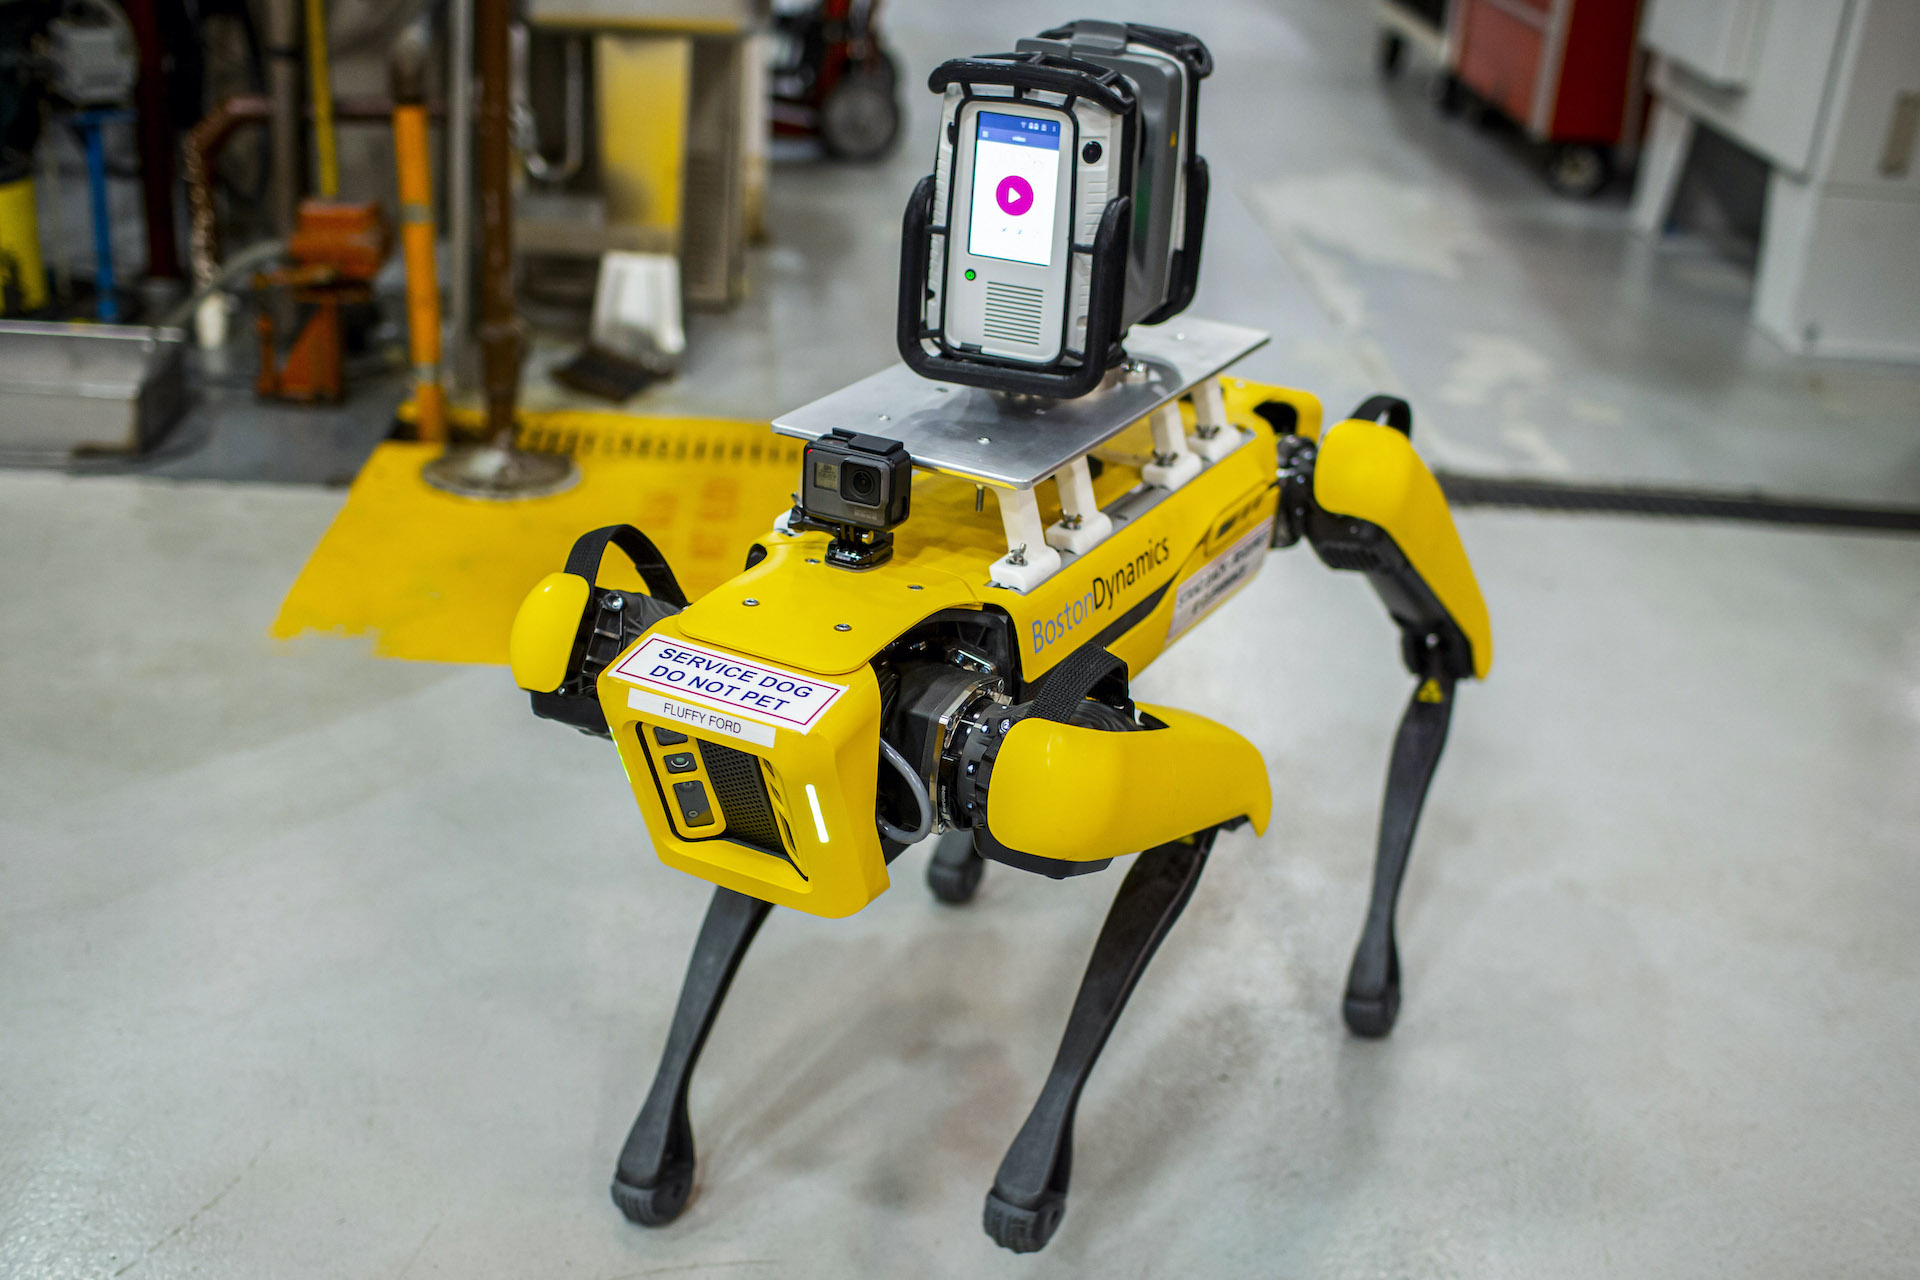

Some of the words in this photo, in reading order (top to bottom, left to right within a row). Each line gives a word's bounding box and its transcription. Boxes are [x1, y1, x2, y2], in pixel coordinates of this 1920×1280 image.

[649, 665, 686, 682] DO
[687, 676, 740, 696] NOT
[739, 690, 790, 711] PET
[658, 648, 758, 682] SERVICE
[758, 676, 813, 698] DOG
[663, 702, 706, 723] FLUFFY
[708, 715, 742, 734] FORD
